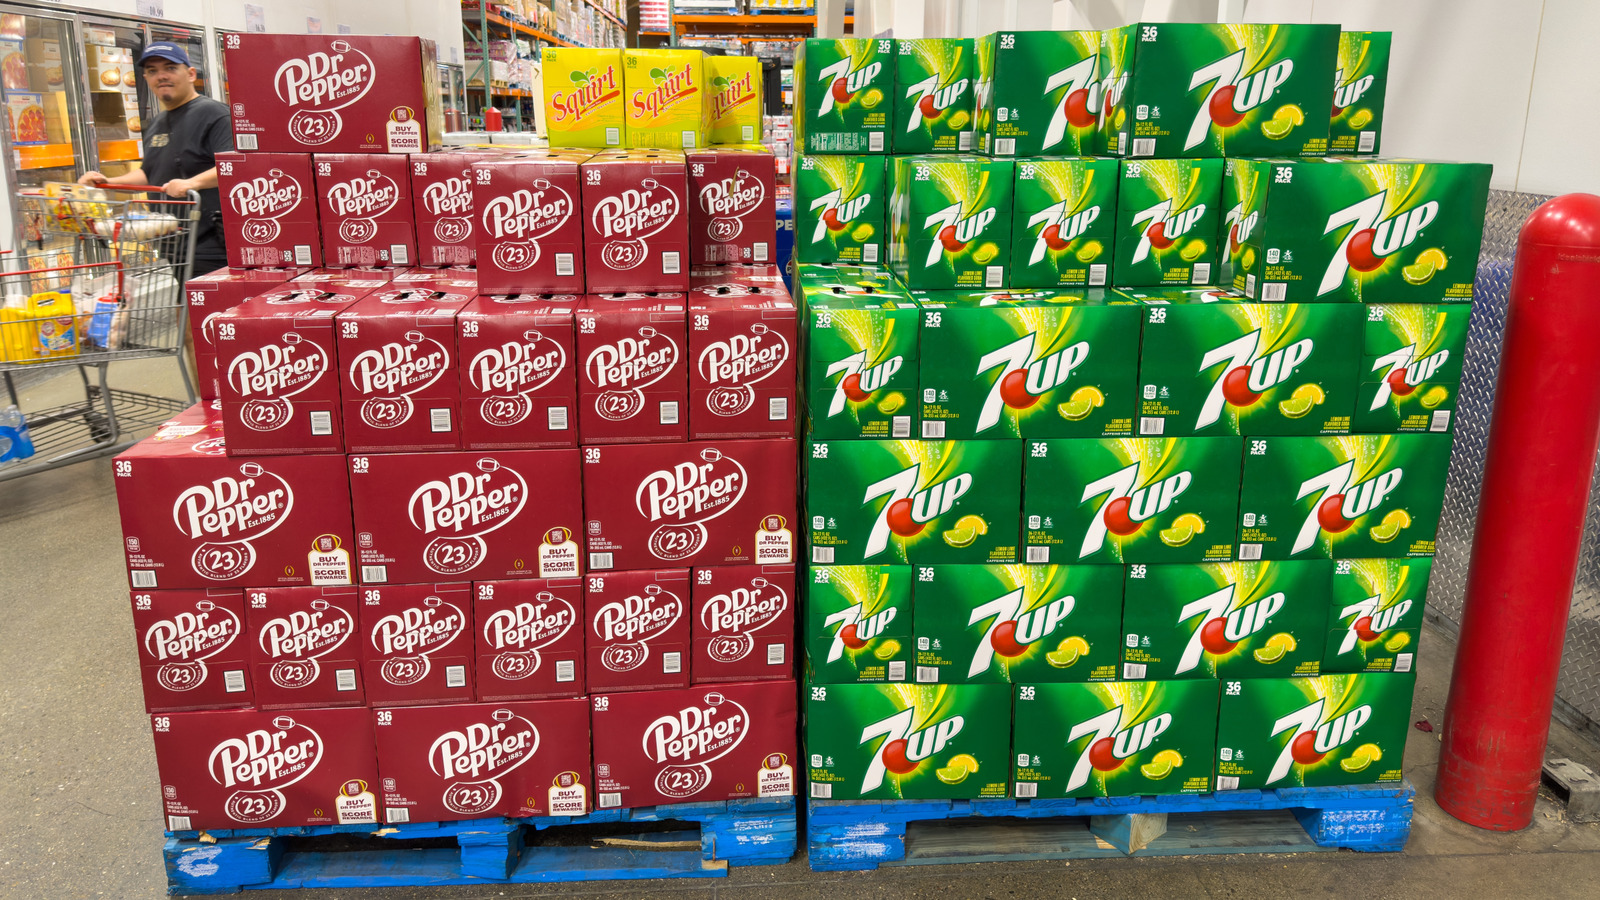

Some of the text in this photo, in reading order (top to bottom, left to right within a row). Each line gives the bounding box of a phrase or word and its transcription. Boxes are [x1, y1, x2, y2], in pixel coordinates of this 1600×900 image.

[227, 35, 240, 45] 36
[1001, 35, 1015, 44] 36
[1142, 26, 1158, 37] 36
[878, 40, 890, 49] 36
[308, 52, 343, 81] Dr
[626, 57, 637, 66] 36
[274, 59, 367, 107] Pepper
[552, 66, 616, 121] Squirt
[633, 64, 692, 118] Squirt
[714, 72, 752, 120] quirt
[304, 117, 324, 136] 23
[220, 162, 233, 171] 36
[414, 163, 427, 172] 36
[587, 170, 601, 181] 36
[693, 164, 704, 172] 36
[916, 167, 929, 176] 36
[1127, 163, 1140, 173] 36
[1275, 167, 1292, 178] 36
[252, 178, 278, 198] Dr
[229, 183, 297, 217] Pepper
[513, 189, 544, 215] Dr
[622, 189, 652, 215] Dr
[482, 196, 565, 238] Pepper
[592, 196, 672, 238] Pepper
[191, 292, 204, 302] 36
[694, 315, 709, 326] 36
[817, 313, 831, 323] 36
[925, 312, 941, 322] 36
[1150, 307, 1167, 318] 36
[219, 324, 235, 335] 36
[463, 321, 478, 332] 36
[382, 343, 417, 370] Dr
[502, 342, 536, 368] Dr
[617, 338, 650, 364] Dr
[730, 334, 761, 360] Dr
[260, 344, 295, 372] Dr
[586, 345, 671, 387] Pepper
[699, 341, 782, 383] Pepper
[228, 352, 319, 396] Pepper
[349, 350, 441, 394] Pepper
[470, 349, 558, 392] Pepper
[376, 403, 396, 419] 23
[586, 448, 600, 459] 36
[812, 444, 828, 453] 36
[1032, 443, 1048, 452] 36
[1250, 440, 1267, 451] 36
[115, 461, 132, 472] 36
[353, 458, 368, 468] 36
[674, 462, 713, 493] Dr
[212, 477, 254, 510] Dr
[449, 472, 490, 505] Dr
[636, 470, 739, 522] Pepper
[173, 485, 284, 539] Pepper
[409, 481, 518, 534] Pepper
[666, 532, 686, 550] 23
[209, 550, 234, 570] 23
[698, 570, 712, 580] 36
[918, 568, 934, 577] 36
[251, 593, 266, 604] 36
[479, 585, 494, 596] 36
[731, 588, 761, 611] Dr
[624, 595, 655, 619] Dr
[701, 594, 780, 632] Pepper
[175, 612, 209, 637] Dr
[402, 608, 436, 632] Dr
[594, 602, 675, 641] Pepper
[145, 619, 232, 660] Pepper
[371, 615, 457, 655] Pepper
[284, 666, 303, 680] 23
[811, 687, 826, 696] 36
[1227, 682, 1241, 690] 36
[595, 697, 609, 707] 36
[154, 717, 170, 727] 36
[678, 706, 716, 736] Dr
[245, 730, 286, 761] Dr
[466, 722, 505, 752] Dr
[642, 715, 741, 763] Pepper
[208, 739, 314, 788] Pepper
[428, 730, 531, 779] Pepper
[460, 788, 481, 805] 23
